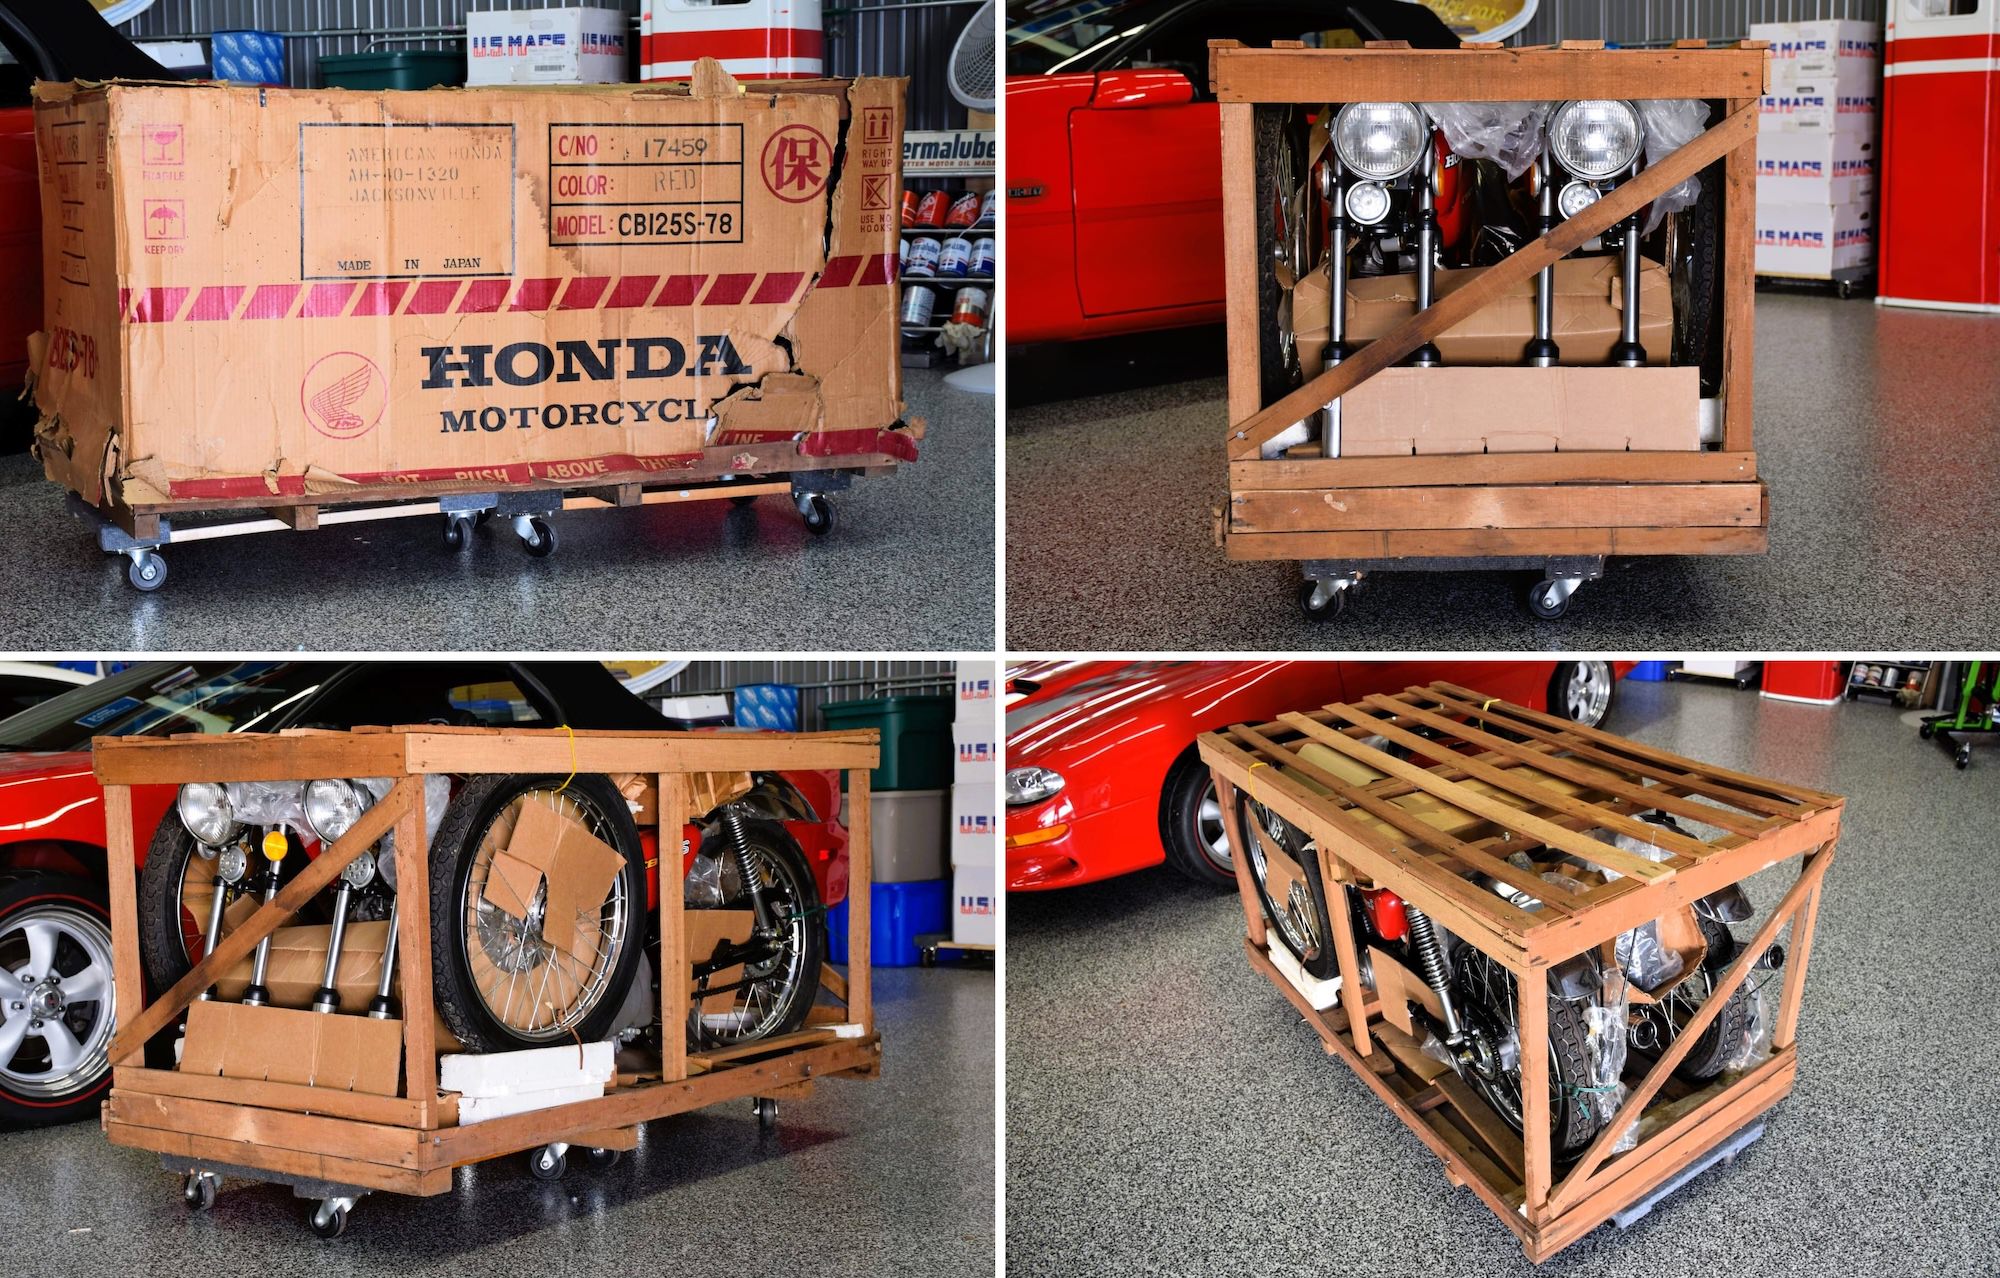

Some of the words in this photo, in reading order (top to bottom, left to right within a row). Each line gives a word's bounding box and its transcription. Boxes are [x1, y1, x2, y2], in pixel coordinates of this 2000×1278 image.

[348, 146, 436, 163] AMERICAN
[448, 145, 502, 161] HONDA
[558, 134, 598, 157] C/NO
[643, 137, 708, 158] 17459
[862, 148, 893, 159] RIGHT
[769, 135, 823, 192] 保
[862, 160, 878, 168] WAY
[881, 159, 893, 168] UP
[142, 171, 185, 183] FRAGILE
[654, 169, 696, 192] RED
[349, 185, 481, 202] JACKSONVILLE
[618, 212, 733, 236] CB125S-78
[860, 214, 874, 224] USE
[879, 214, 892, 223] NO
[860, 224, 892, 233] HOOKS
[144, 245, 166, 255] KEEP
[168, 244, 185, 254] DRY
[337, 260, 371, 271] MADE
[404, 259, 420, 270] IN
[443, 257, 481, 269] JAPAN
[421, 335, 753, 390] HONDA
[547, 460, 609, 480] ABOVE
[640, 456, 681, 471] THIS
